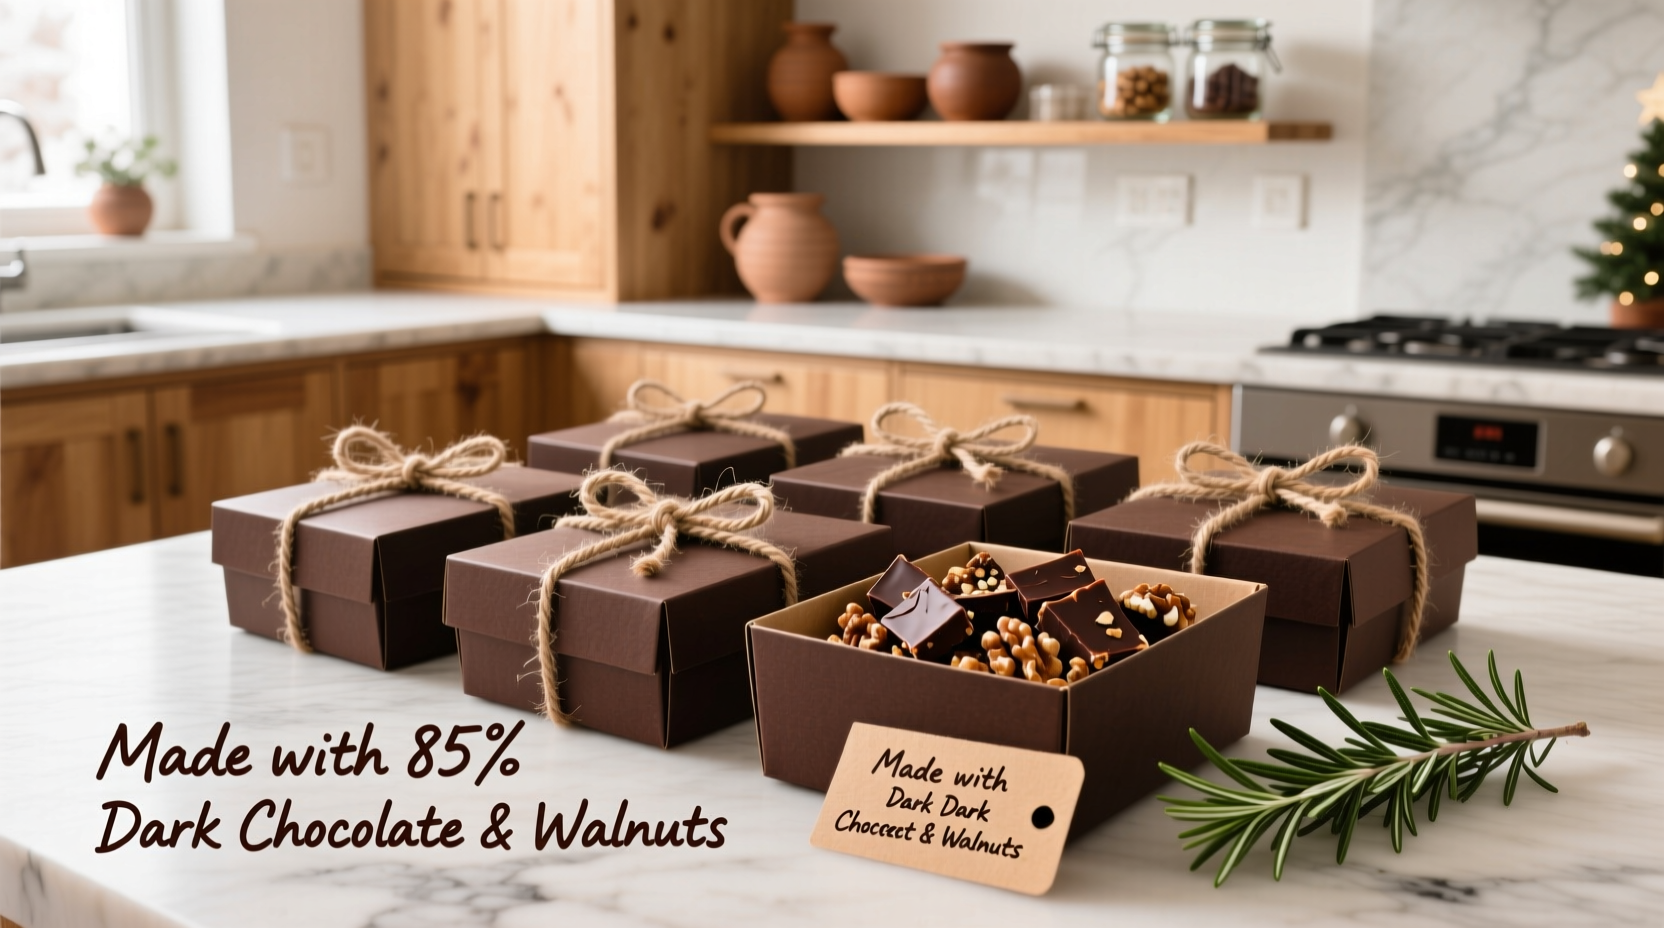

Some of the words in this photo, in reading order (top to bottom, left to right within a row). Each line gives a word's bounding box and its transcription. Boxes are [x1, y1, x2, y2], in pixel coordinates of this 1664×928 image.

[871, 748, 943, 783] Made
[953, 765, 1008, 792] with
[886, 786, 934, 813] Dark
[940, 794, 991, 822] Dark
[919, 822, 936, 844] &
[941, 825, 1023, 859] Walnuts
